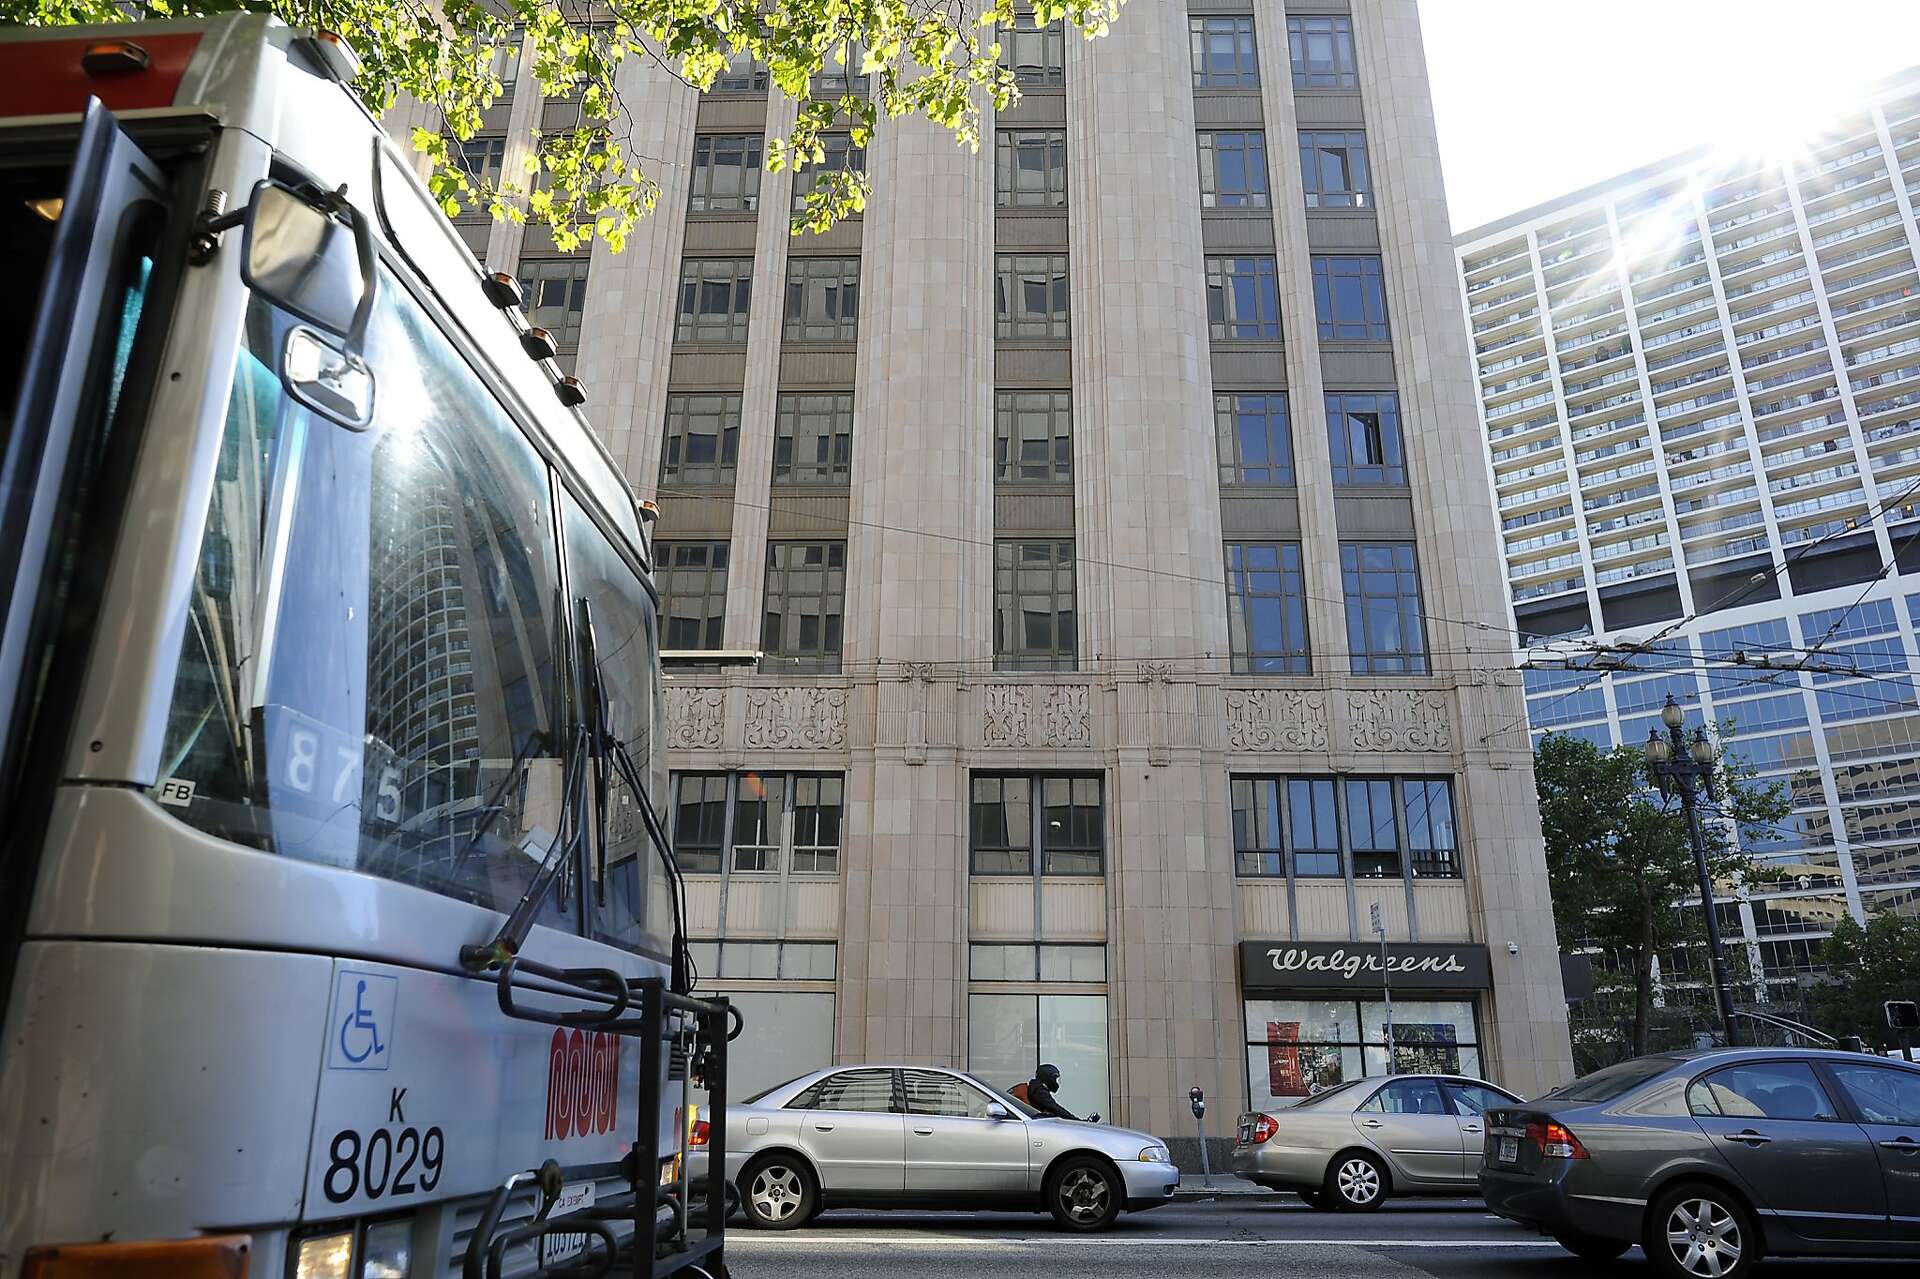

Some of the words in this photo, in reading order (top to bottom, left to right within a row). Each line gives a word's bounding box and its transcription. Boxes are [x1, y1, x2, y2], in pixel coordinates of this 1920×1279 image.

[162, 782, 190, 800] FB
[1266, 948, 1465, 979] Walgreens
[388, 1087, 408, 1123] K
[323, 1126, 444, 1204] 8029
